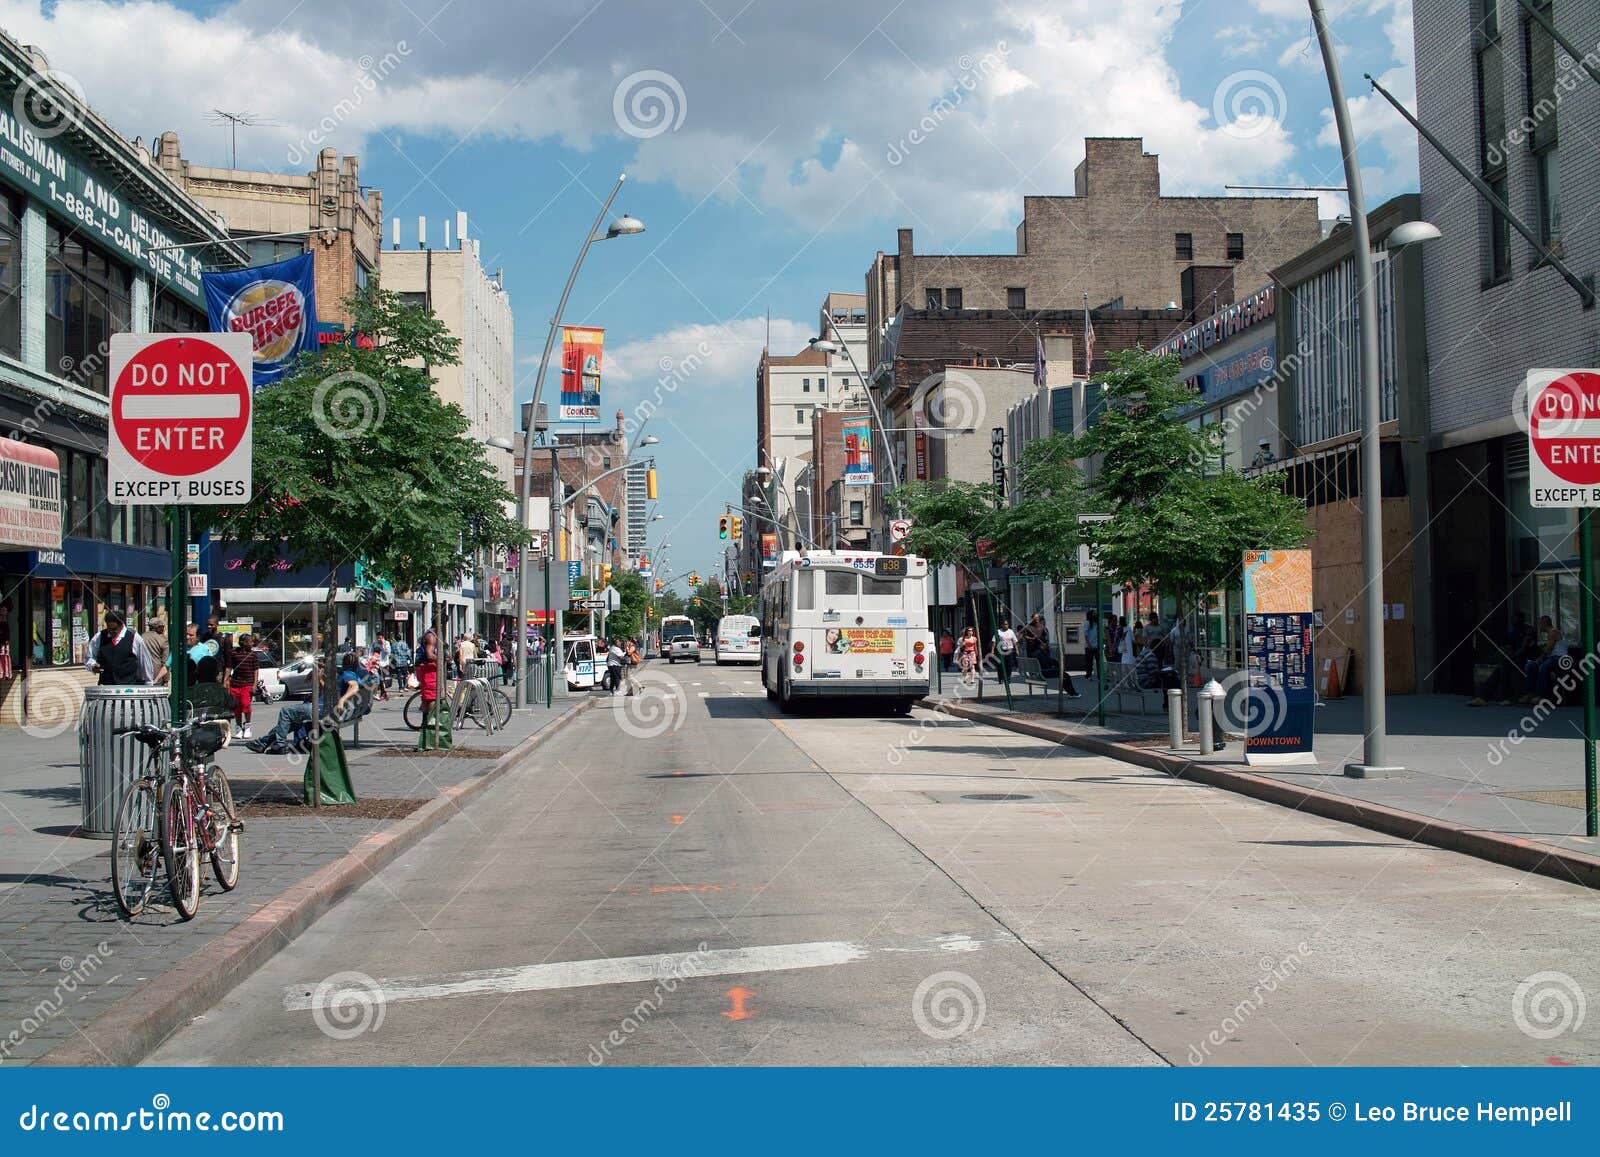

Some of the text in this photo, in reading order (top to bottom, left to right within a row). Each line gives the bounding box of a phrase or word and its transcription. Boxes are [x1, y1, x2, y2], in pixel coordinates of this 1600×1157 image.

[0, 110, 66, 182] ALISMAN
[83, 176, 120, 219] AND
[230, 290, 297, 332] BURGER
[132, 363, 230, 386] DO NOT
[1545, 393, 1573, 412] DO
[136, 427, 225, 450] ENTER
[1551, 445, 1600, 464] ENTE
[28, 467, 58, 500] HEWITT
[114, 481, 245, 497] EXCEPT BUSES
[1535, 488, 1587, 502] EXCEPT
[29, 498, 59, 513] TAX SERVICE
[853, 561, 875, 569] 6535
[1247, 736, 1301, 746] DOWNTOWN
